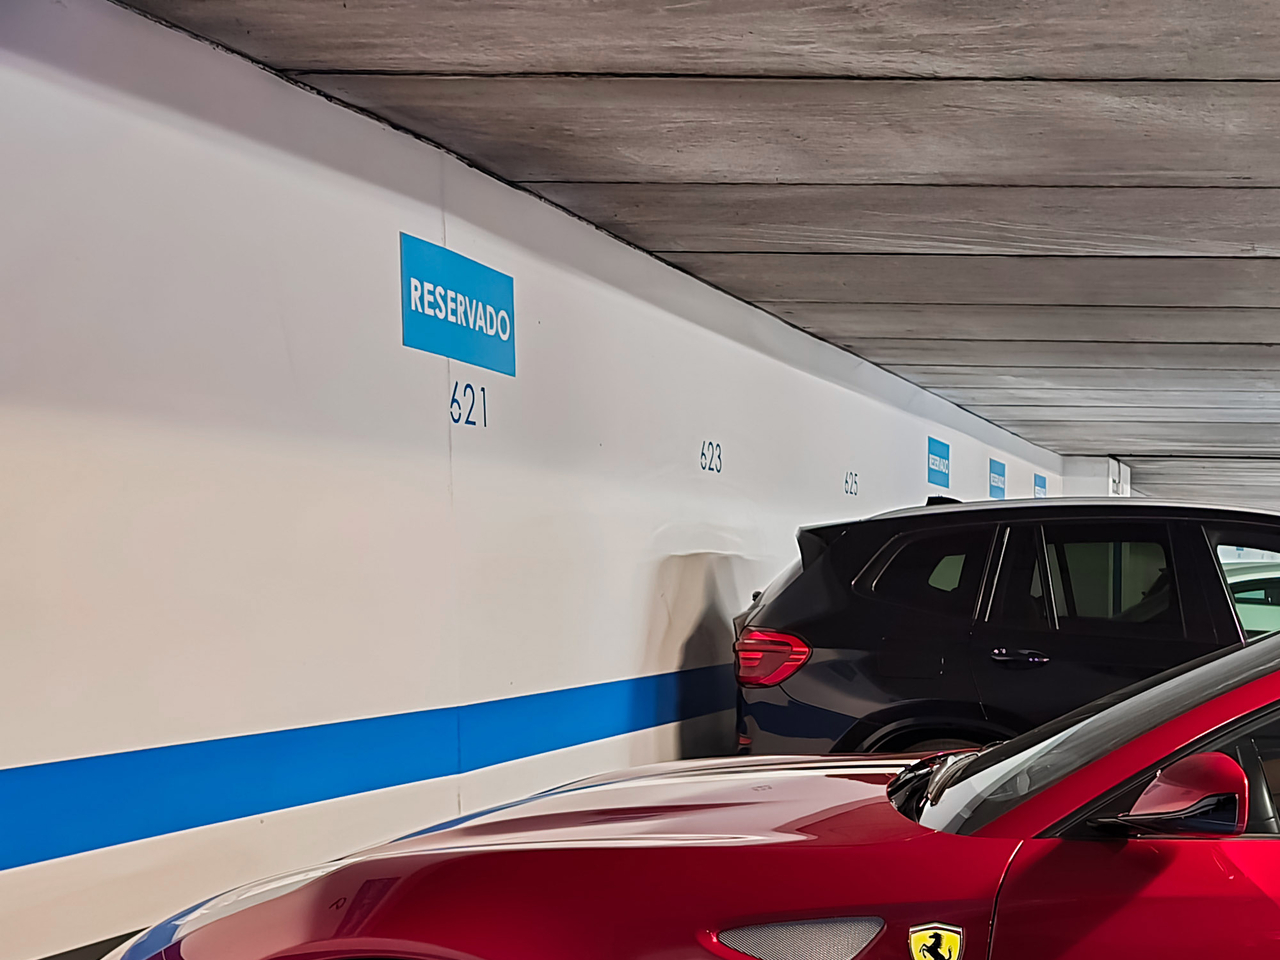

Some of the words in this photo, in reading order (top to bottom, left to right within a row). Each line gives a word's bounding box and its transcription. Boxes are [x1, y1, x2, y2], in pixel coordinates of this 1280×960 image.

[410, 277, 510, 341] RESERVADO
[450, 381, 487, 427] 621
[700, 440, 722, 473] 623
[844, 471, 859, 496] 625
